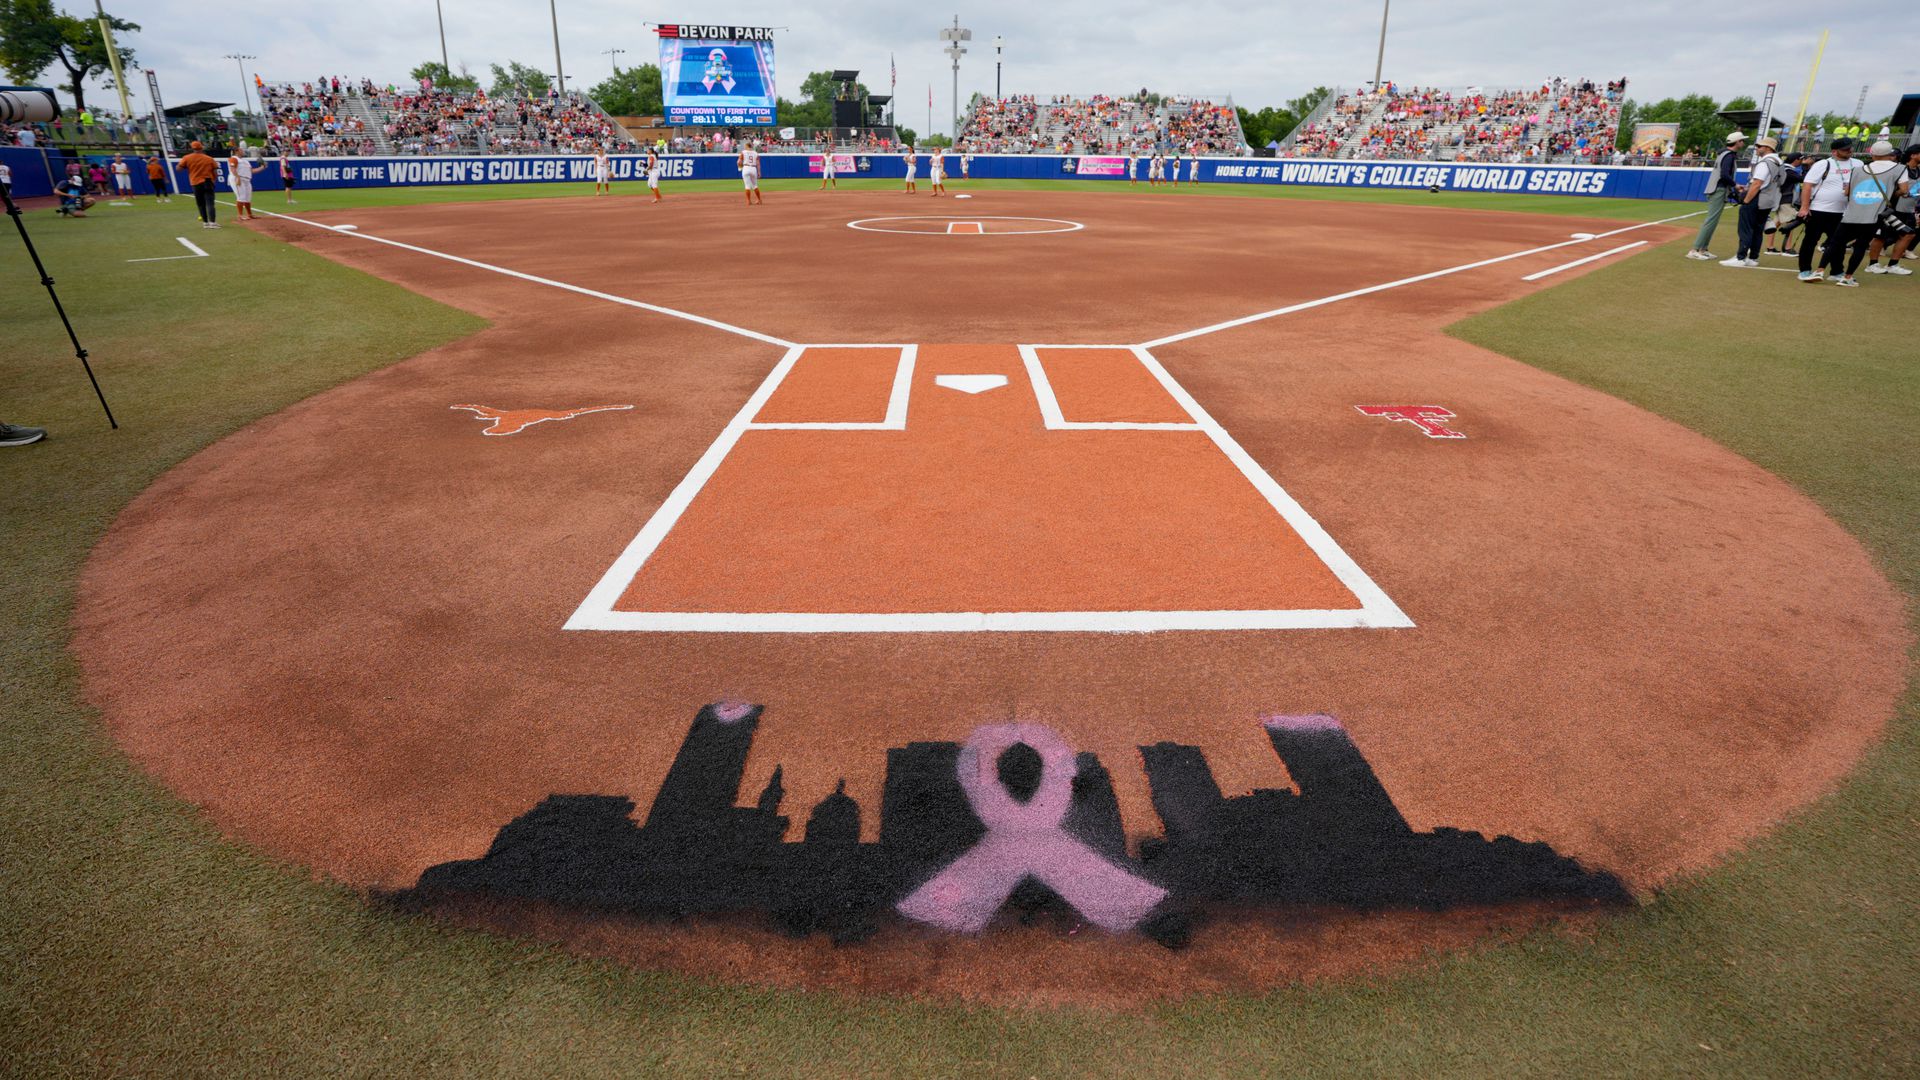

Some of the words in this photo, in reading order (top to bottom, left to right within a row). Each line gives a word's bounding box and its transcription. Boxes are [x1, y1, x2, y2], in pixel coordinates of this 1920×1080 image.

[679, 25, 729, 39] DEVON
[735, 27, 774, 40] PARK
[670, 107, 715, 115] COUNTDOWN
[301, 167, 339, 181] HOME
[342, 166, 359, 180] OF
[361, 166, 385, 179] THE
[387, 161, 485, 183] WOMEN'S
[487, 160, 566, 181] COLLEGE
[569, 159, 632, 179] WOLD
[634, 159, 694, 178] SRIES
[1215, 165, 1245, 177] HOME
[1245, 166, 1260, 178] OF
[1260, 166, 1280, 178] THE
[1281, 163, 1368, 185] WOMEN'S
[1368, 166, 1451, 187] COLLEGE
[1452, 168, 1527, 190] WORLD
[1527, 170, 1608, 193] SERIES
